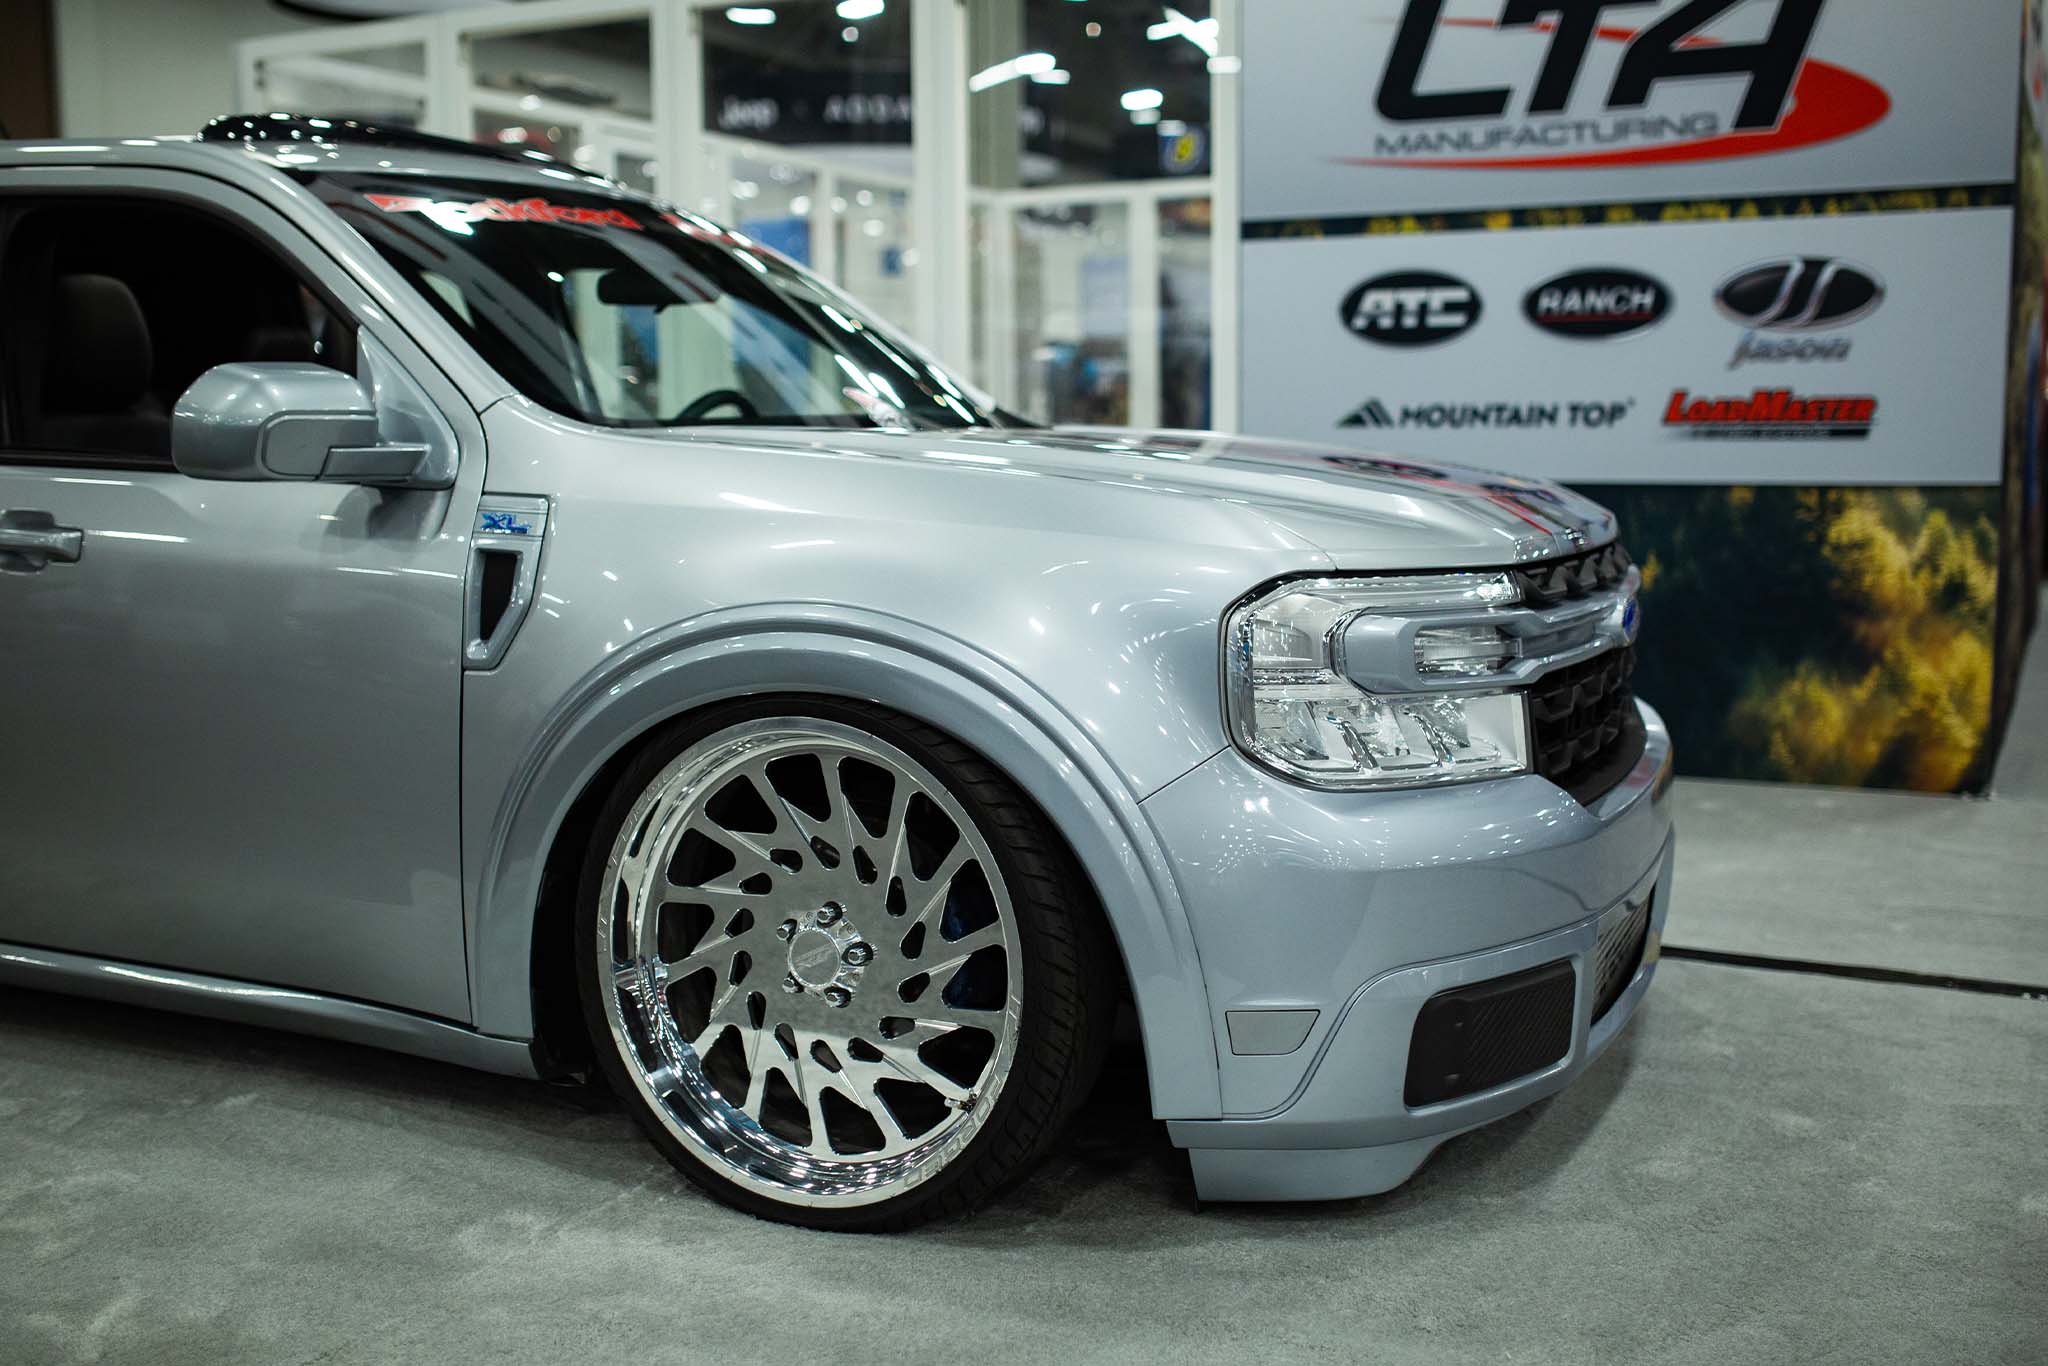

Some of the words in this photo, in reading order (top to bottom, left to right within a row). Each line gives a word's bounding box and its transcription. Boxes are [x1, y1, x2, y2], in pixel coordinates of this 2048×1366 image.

[1374, 110, 1718, 156] MANUFACTURING
[1352, 287, 1471, 329] ATC
[1537, 286, 1656, 316] RANCH
[1401, 402, 1559, 429] MOUNTAIN
[480, 512, 532, 534] XL
